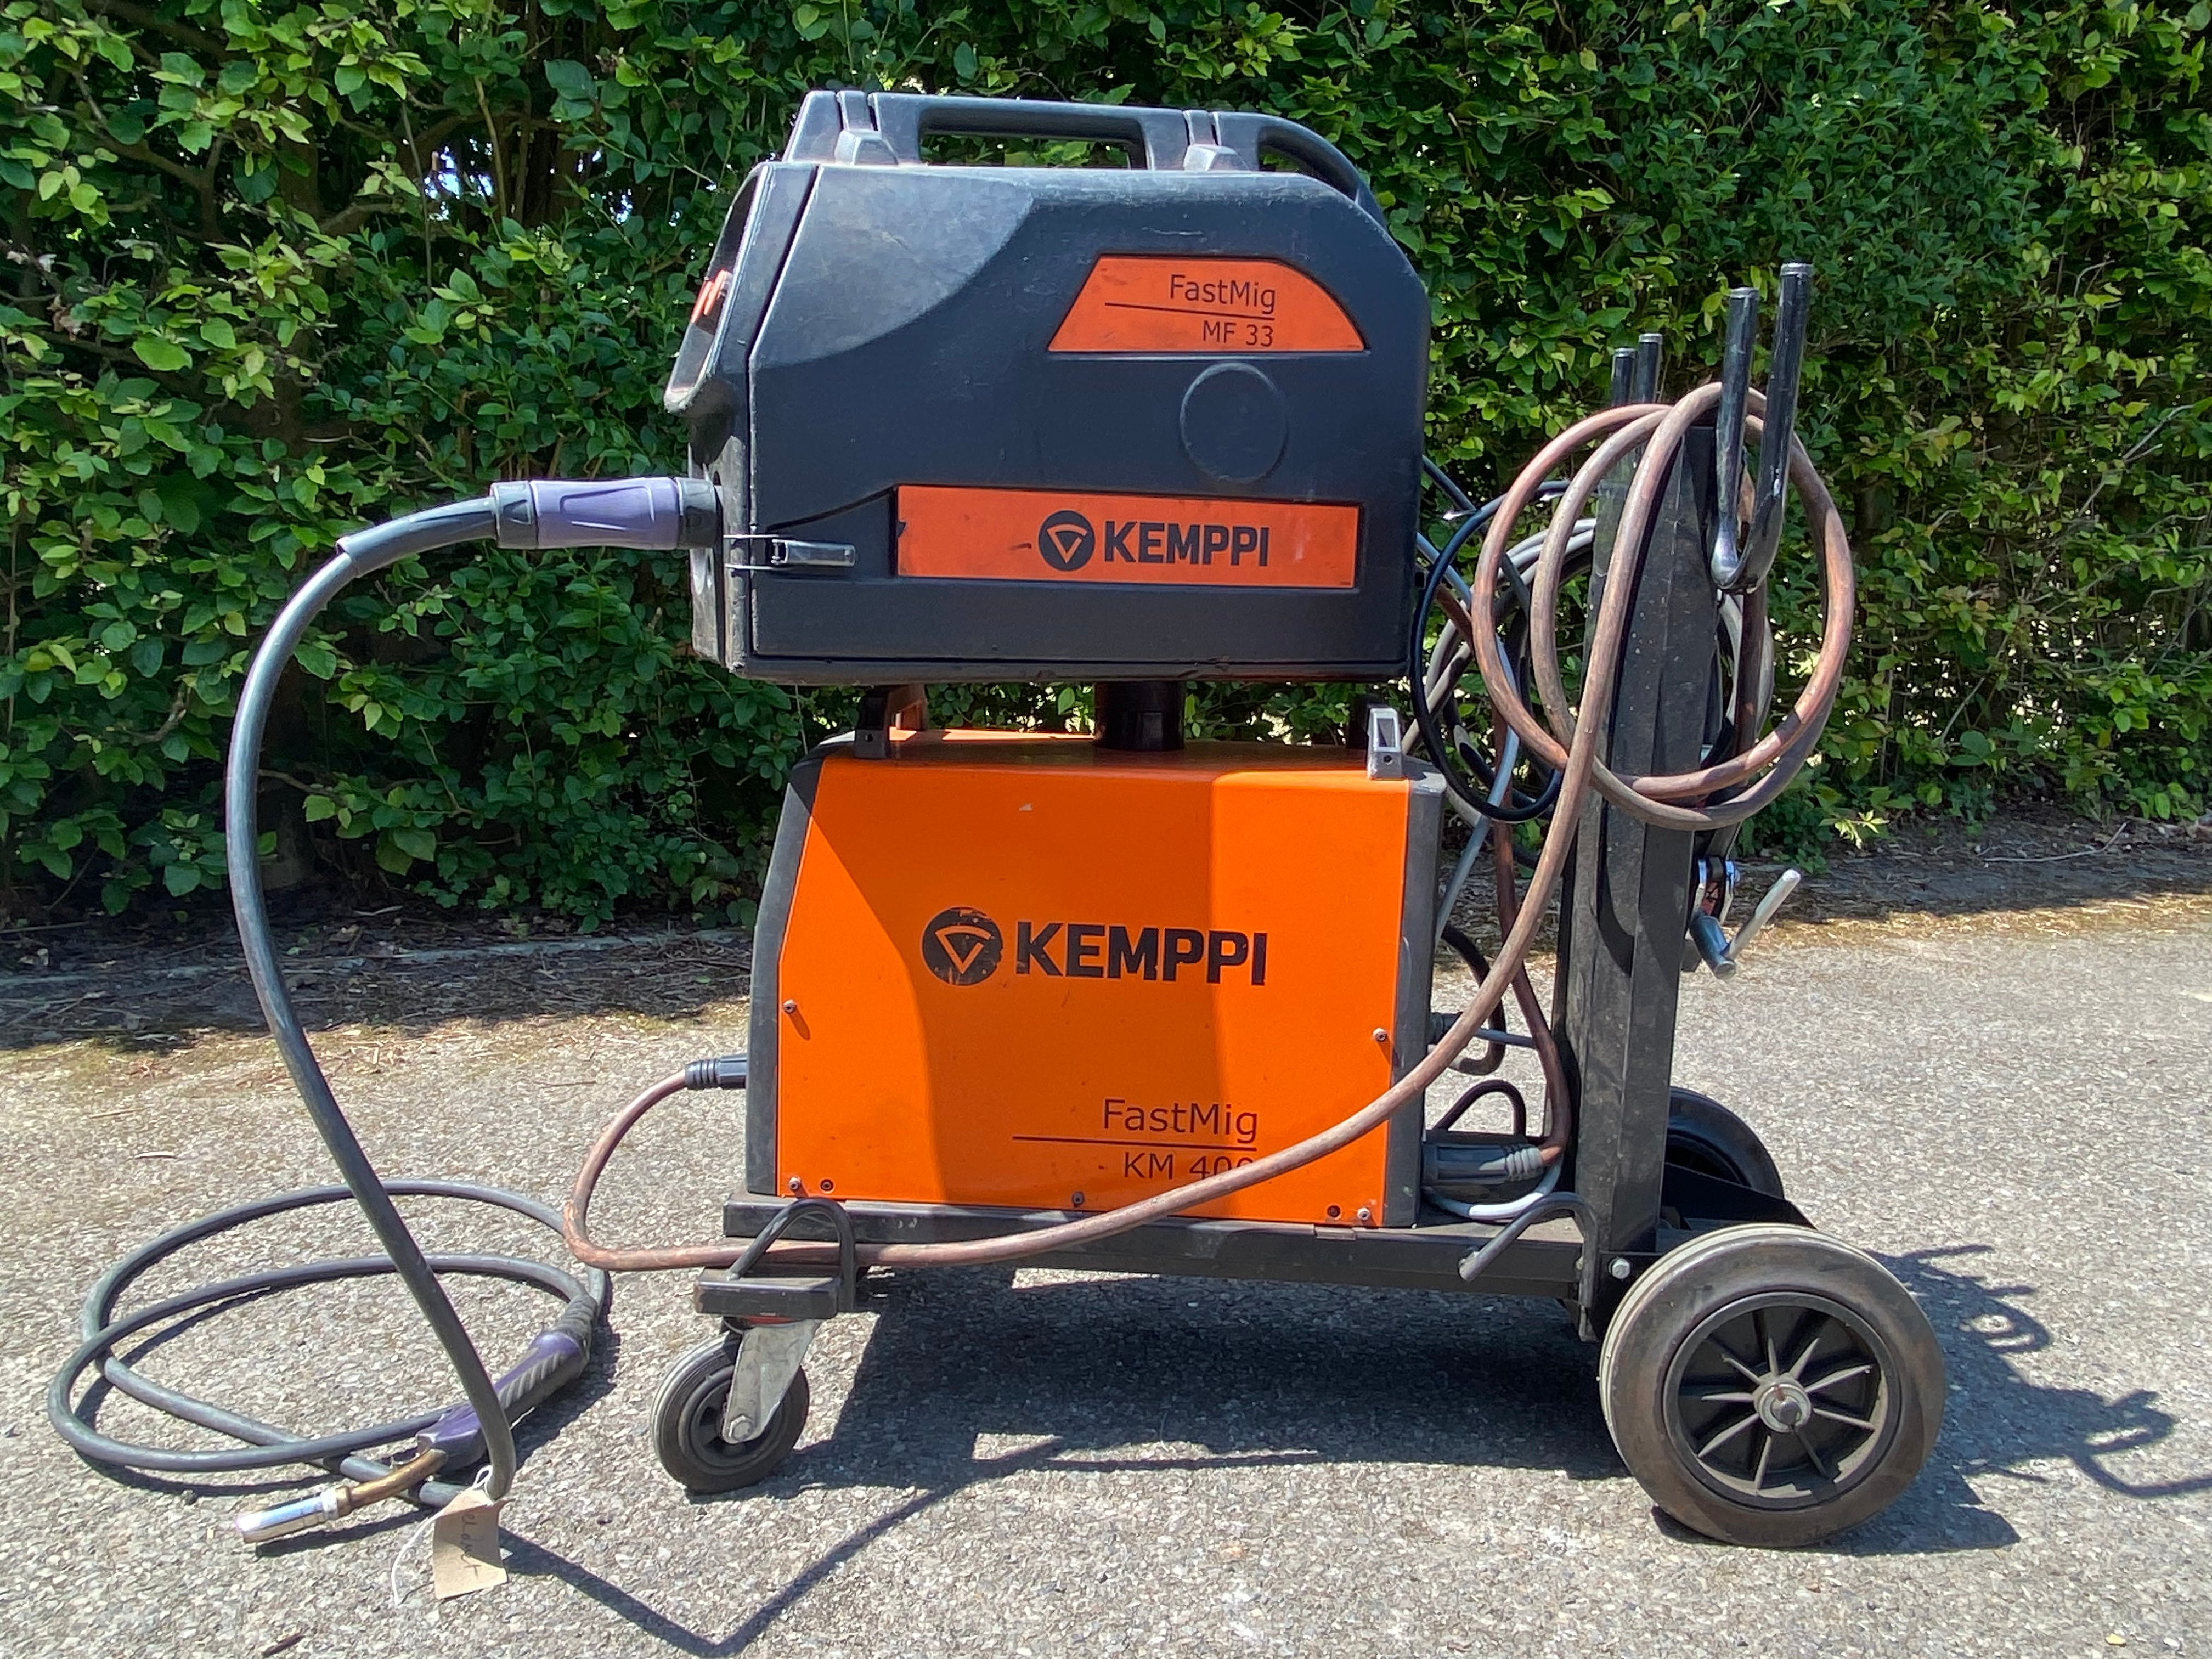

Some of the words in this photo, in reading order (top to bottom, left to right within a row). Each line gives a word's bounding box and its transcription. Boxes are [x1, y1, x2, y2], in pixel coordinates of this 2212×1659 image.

[1169, 274, 1276, 315] FastMig
[1202, 320, 1237, 343] MF
[1245, 324, 1273, 347] 33
[1104, 520, 1270, 567] KEMPPI
[1015, 921, 1268, 986] KEMPPI
[1103, 1098, 1257, 1144] FastMig
[1124, 1152, 1173, 1180] KM
